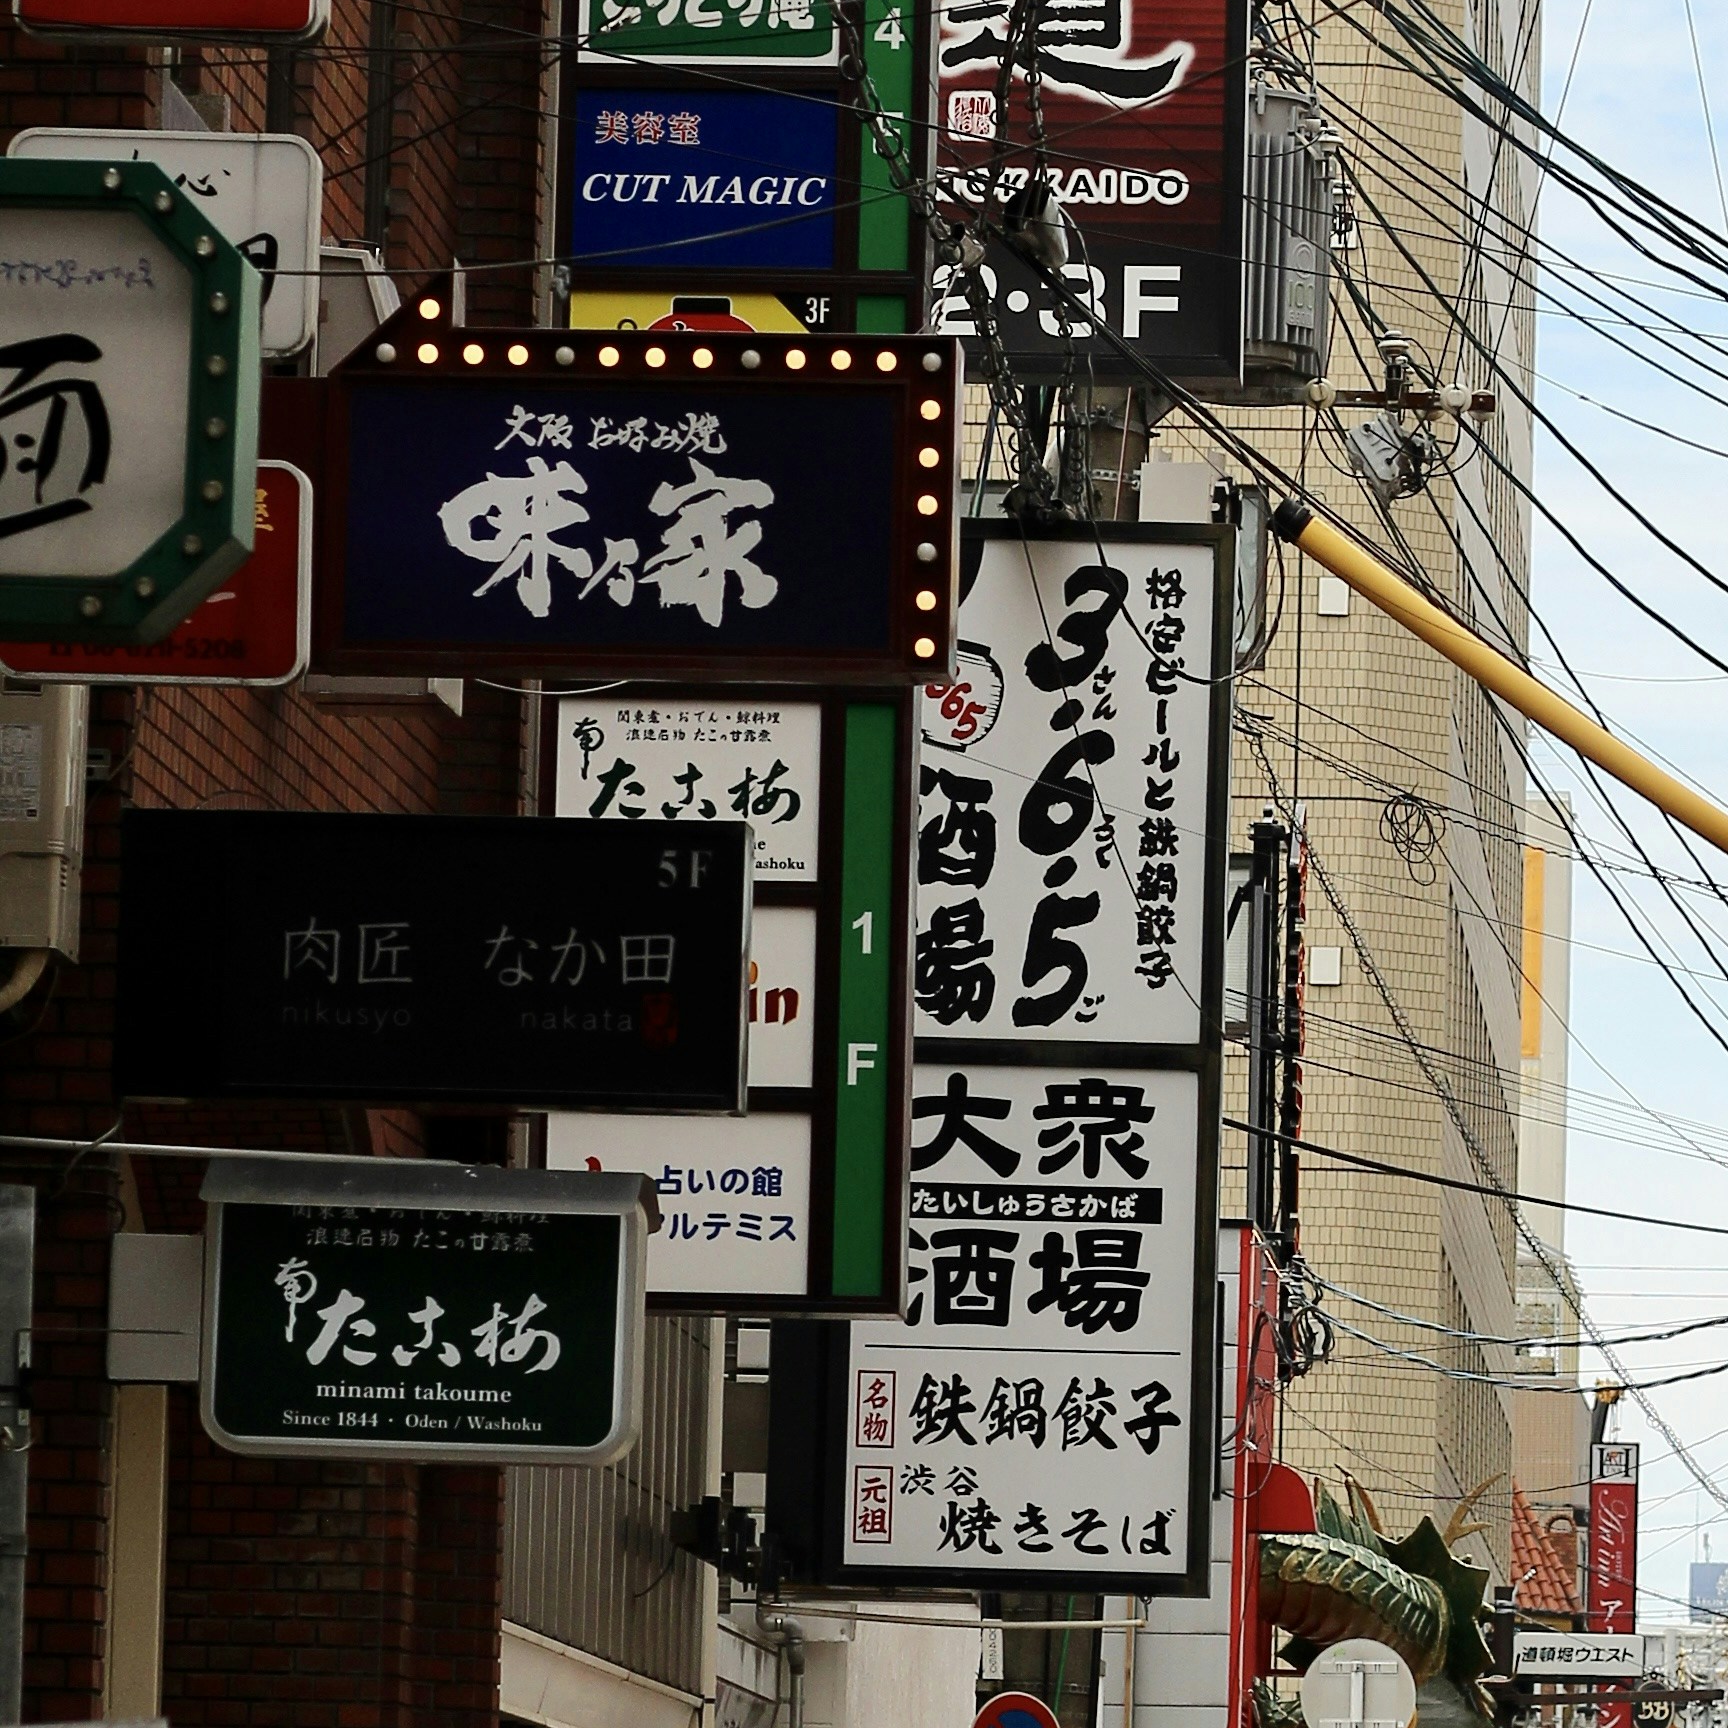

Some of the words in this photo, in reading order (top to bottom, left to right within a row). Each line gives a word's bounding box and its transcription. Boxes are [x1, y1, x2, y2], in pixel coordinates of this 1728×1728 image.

[594, 109, 703, 146] 美容室
[582, 173, 668, 204] CUT
[676, 175, 829, 206] MAGIC
[804, 296, 831, 325] 3F
[494, 403, 574, 452] 大阪
[587, 410, 727, 455] お好み焼
[1134, 567, 1187, 991] 格安ビールと鉄鍋餃子
[753, 857, 806, 871] ashoku
[281, 915, 415, 986] 肉匠
[484, 923, 677, 988] なか田
[911, 1073, 1156, 1180] 大衆
[656, 1164, 784, 1198] 占いの館
[913, 1188, 1138, 1219] たいしゅうさかば
[658, 1212, 798, 1243] ルテミス
[902, 1227, 1152, 1335] 酒場
[316, 1379, 406, 1400] minami
[414, 1383, 513, 1404] takoume
[282, 1409, 332, 1428] Since
[337, 1411, 379, 1428] 1844
[405, 1413, 448, 1431] Oden
[466, 1415, 544, 1434] Washoku
[861, 1376, 888, 1442] 名物
[908, 1372, 1182, 1456] 鉄鍋餃子
[859, 1476, 888, 1536] 元祖
[899, 1463, 980, 1496] 渋谷
[936, 1499, 1178, 1557] 焼きそば
[1521, 1645, 1636, 1665] 道頓堀ウエスト
